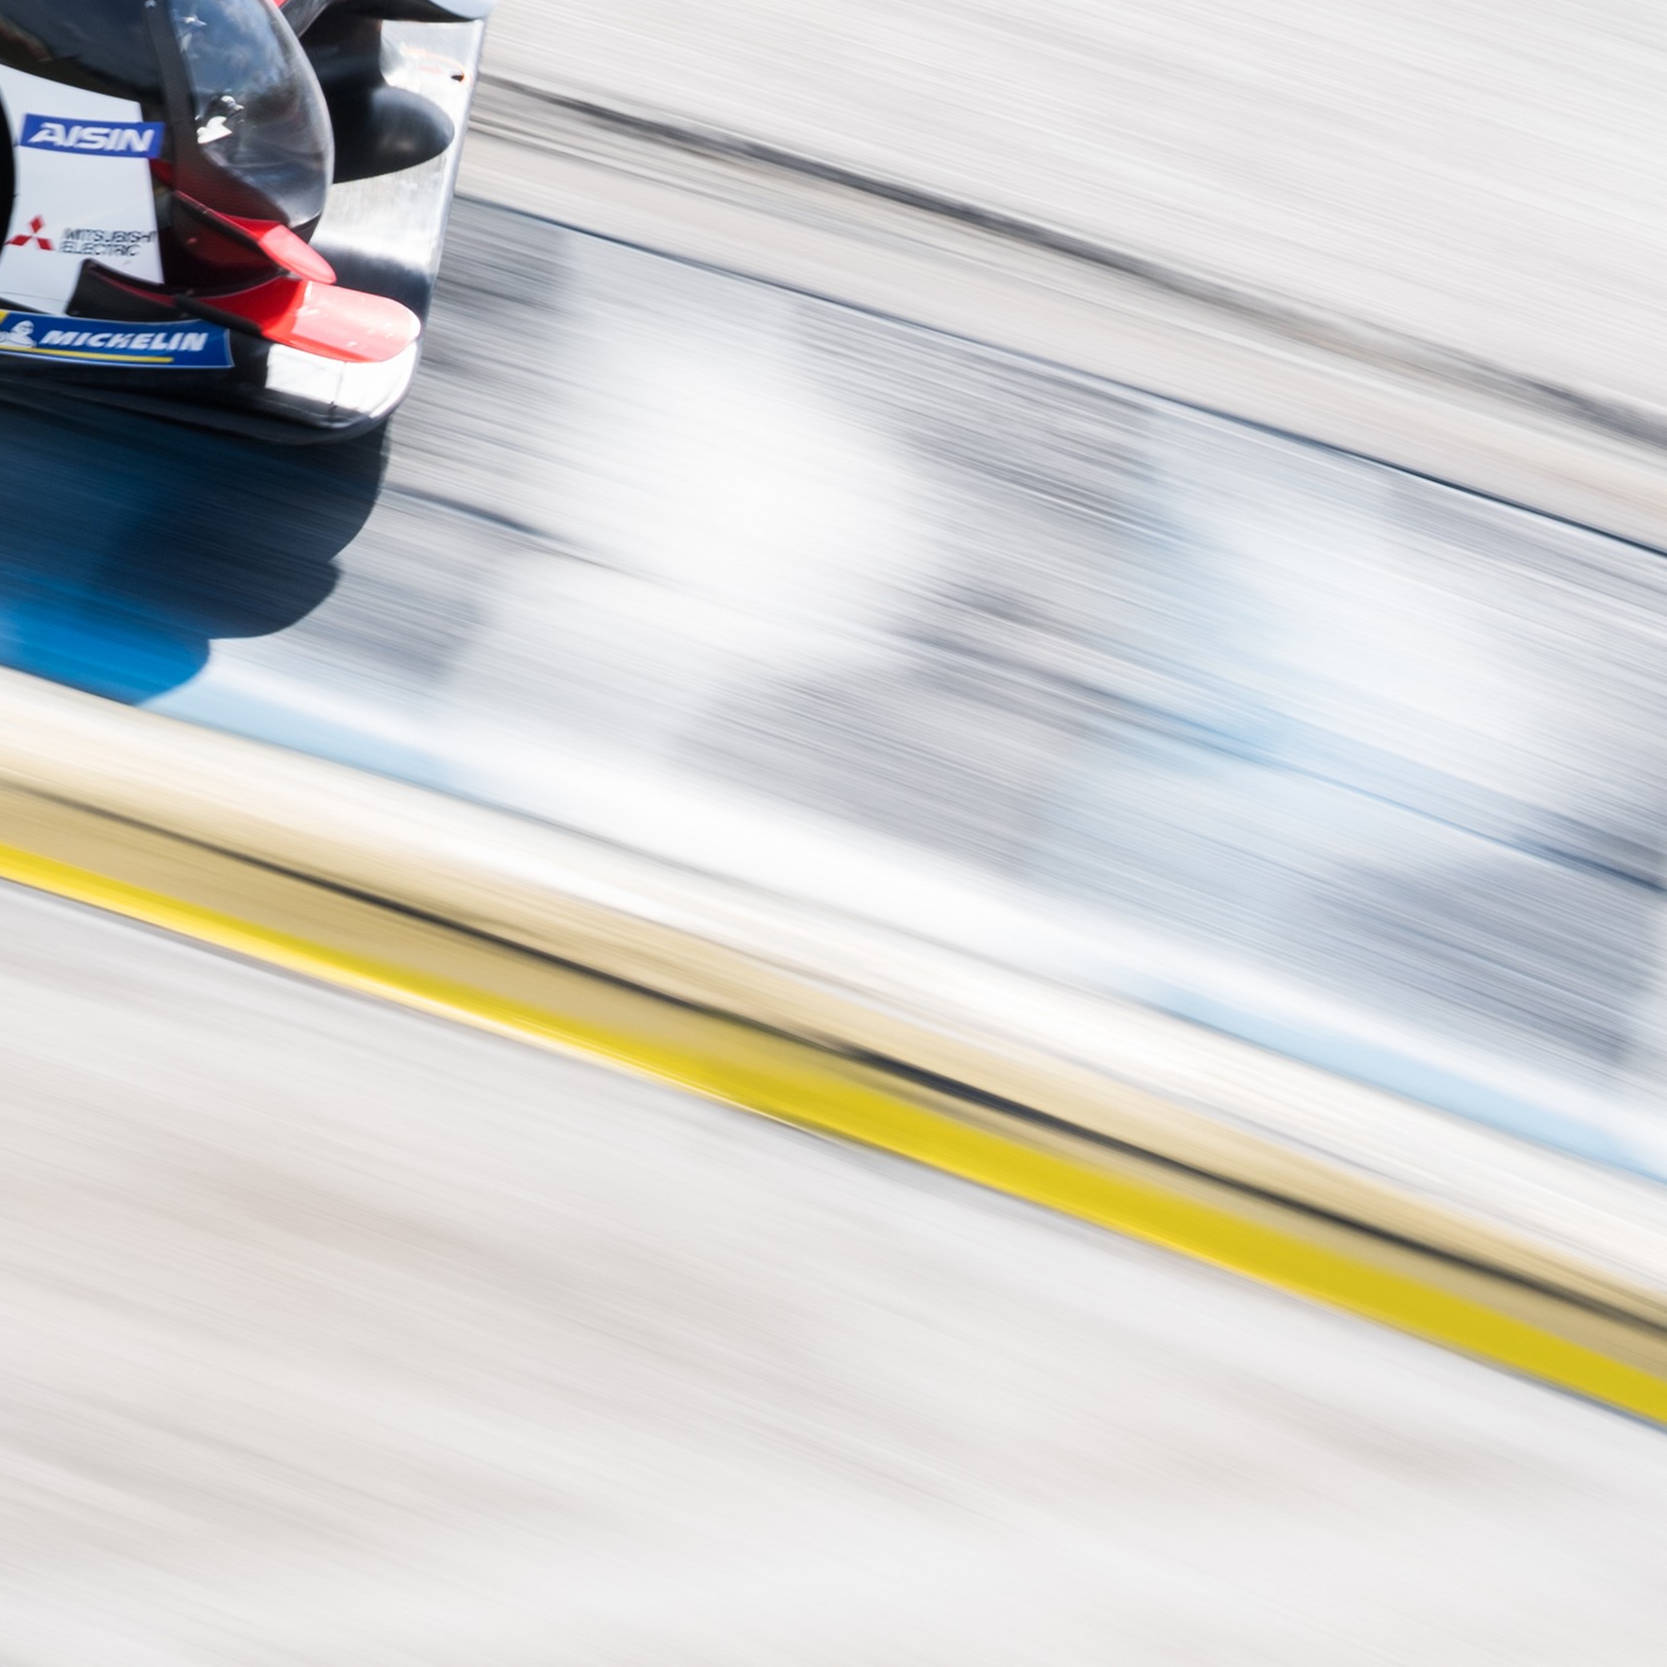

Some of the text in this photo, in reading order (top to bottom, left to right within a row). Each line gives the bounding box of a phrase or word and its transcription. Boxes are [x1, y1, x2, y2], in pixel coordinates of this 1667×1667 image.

[26, 121, 156, 153] AISIN
[62, 227, 158, 244] MITSUBISHI
[59, 240, 142, 257] ELECTRIC
[38, 329, 210, 353] MICHELIN
